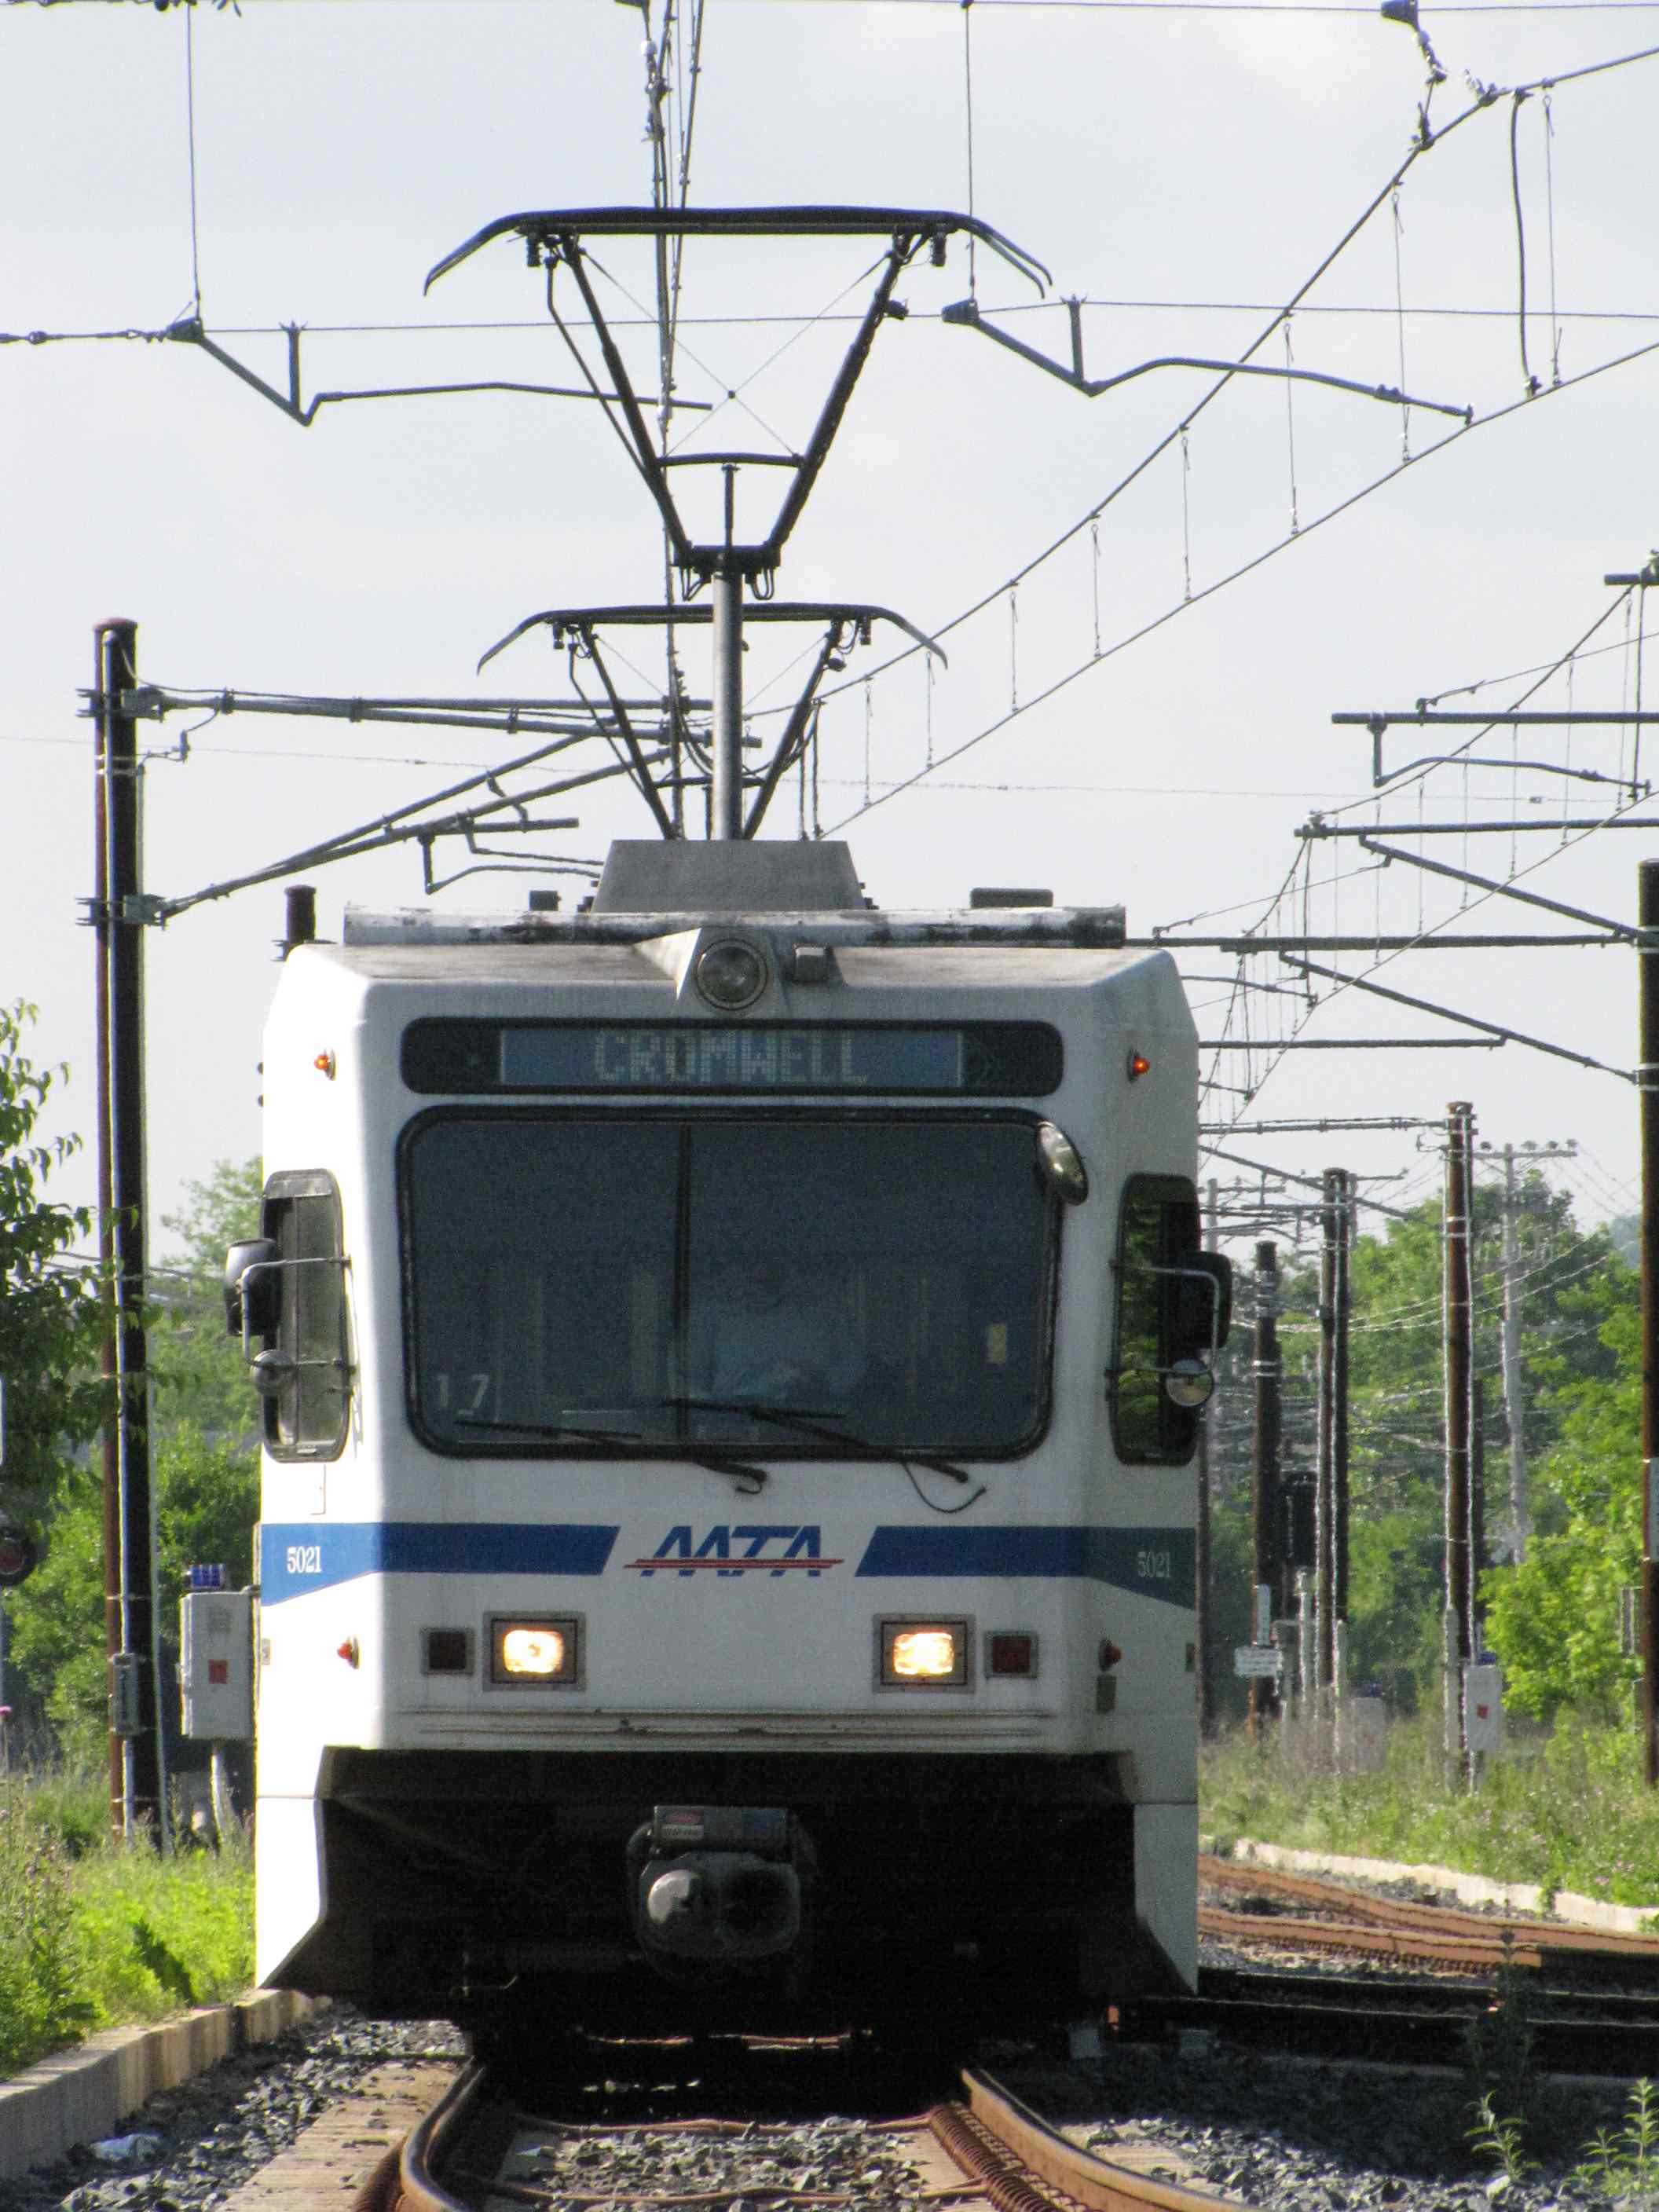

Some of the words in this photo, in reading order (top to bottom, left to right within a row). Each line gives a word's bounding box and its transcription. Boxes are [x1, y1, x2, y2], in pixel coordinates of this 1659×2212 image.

[594, 1030, 867, 1082] CROMWELL
[287, 1545, 321, 1573] 5021
[639, 1525, 822, 1577] MTA
[1137, 1551, 1170, 1579] 5021
